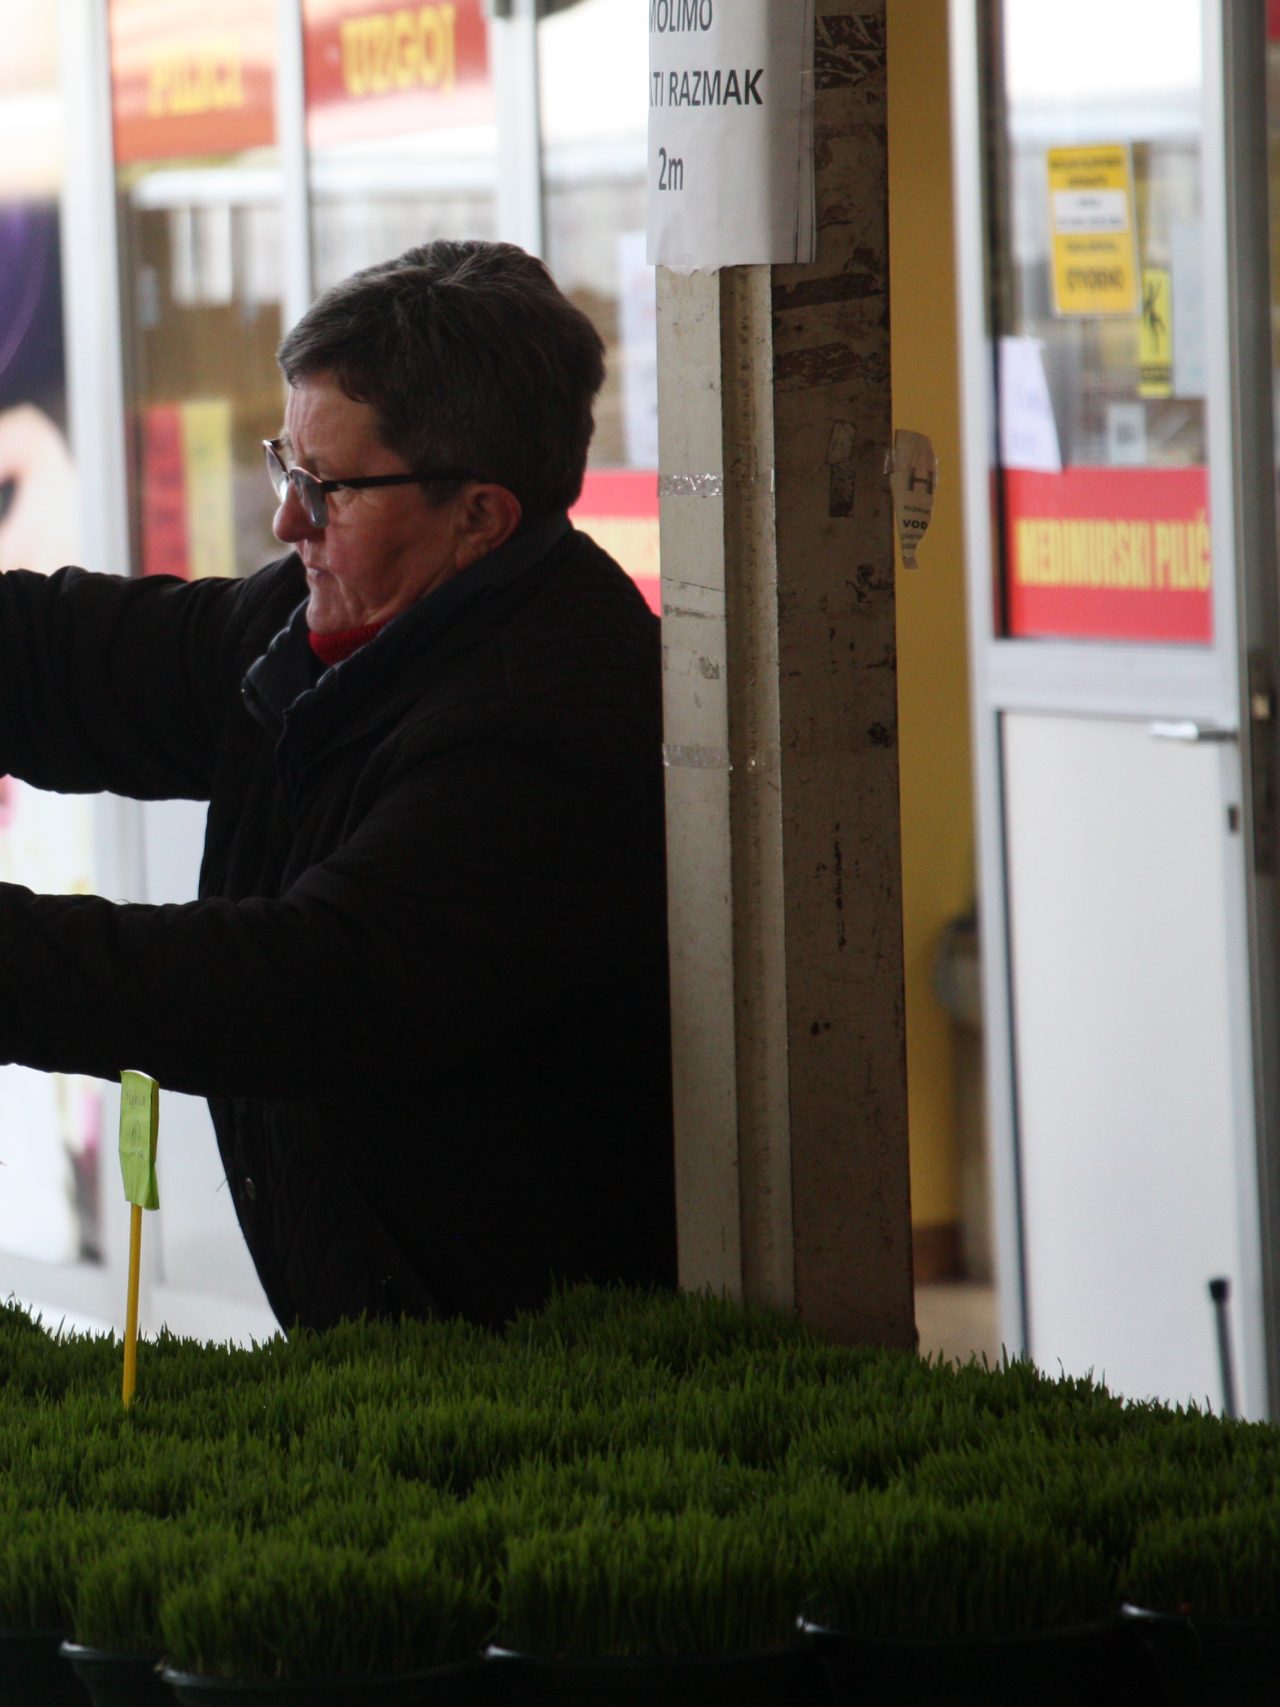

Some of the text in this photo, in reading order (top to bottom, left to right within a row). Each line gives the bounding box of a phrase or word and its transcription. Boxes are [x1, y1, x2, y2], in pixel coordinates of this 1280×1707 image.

[669, 69, 764, 106] RAZMAK
[658, 147, 683, 191] 2m
[1154, 508, 1210, 590] PILIĆ
